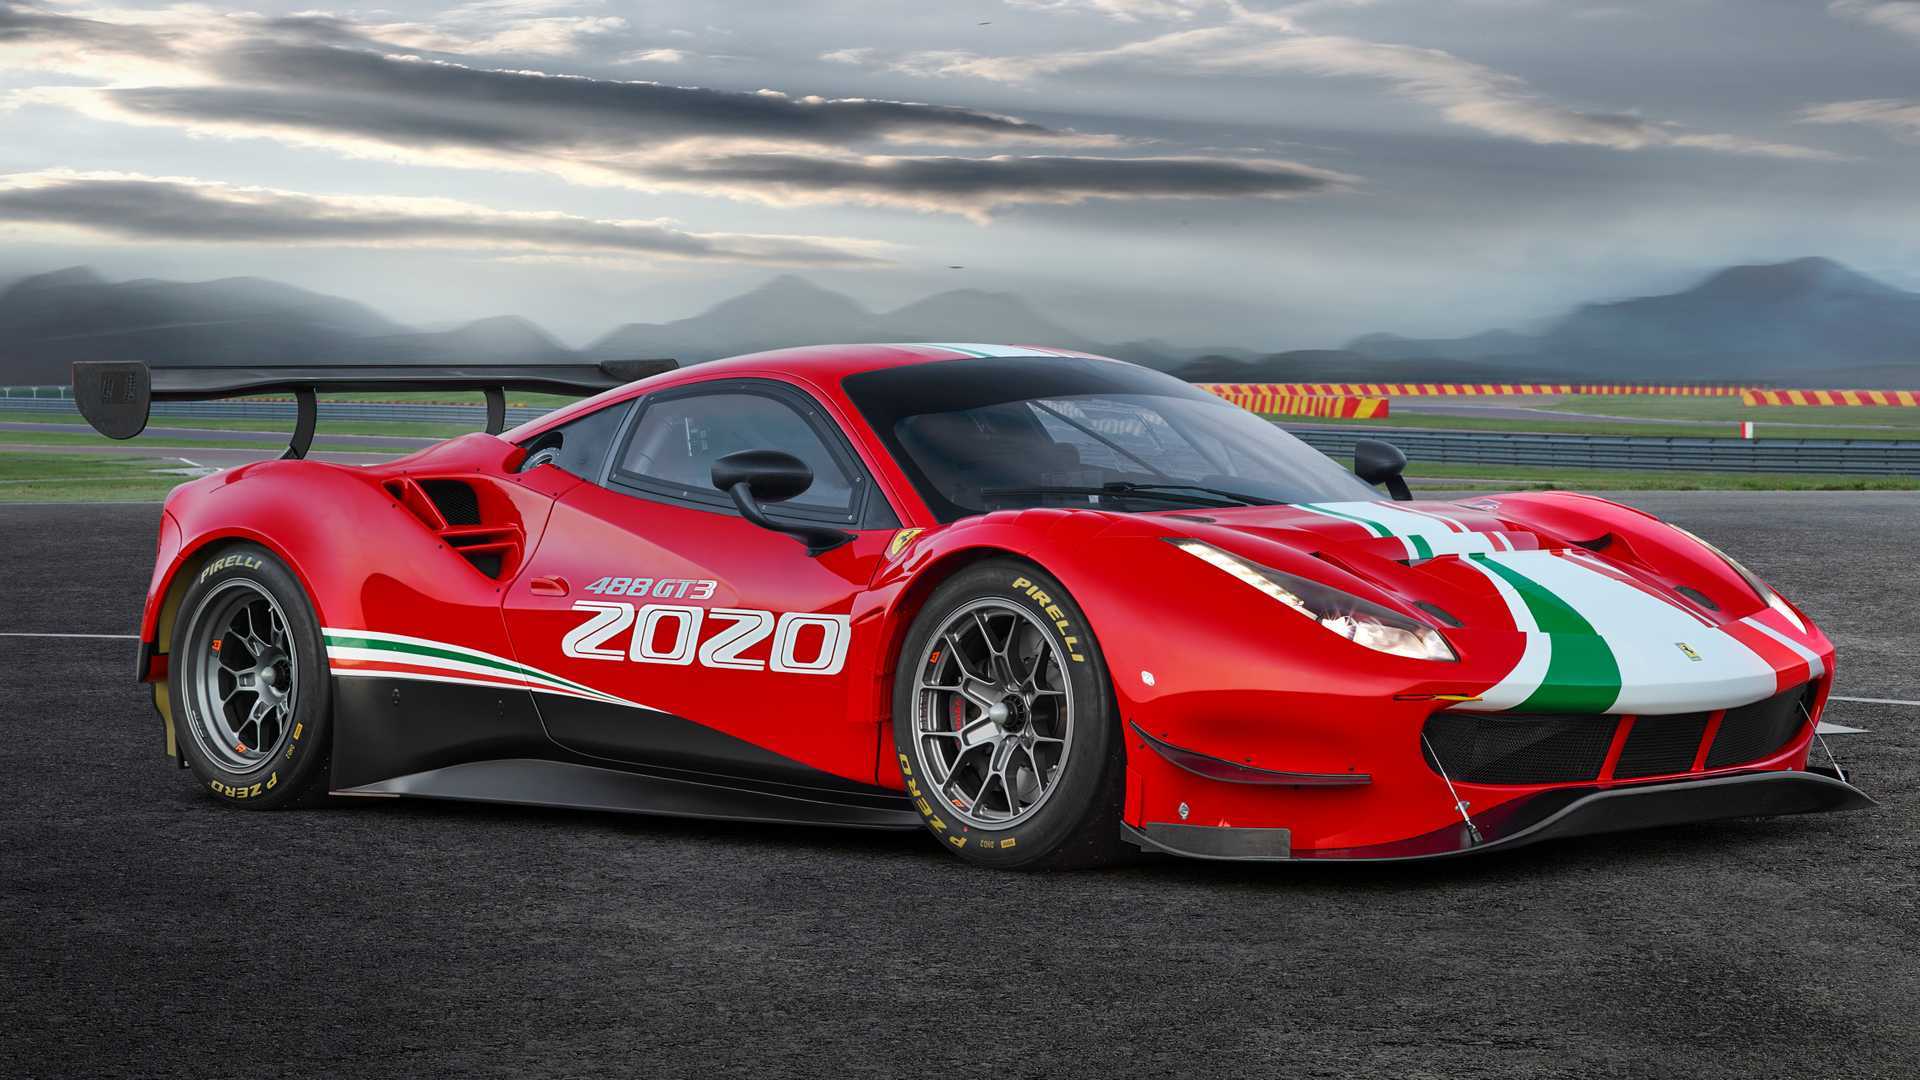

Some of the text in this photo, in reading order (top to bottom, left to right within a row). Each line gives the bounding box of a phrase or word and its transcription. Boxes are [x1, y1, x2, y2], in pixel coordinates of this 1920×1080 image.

[200, 555, 262, 584] PIRELLI
[584, 576, 717, 600] 488 GT3
[561, 600, 851, 676] 2020
[1012, 577, 1084, 662] PIRELLI
[210, 771, 278, 799] P ZERO
[899, 753, 967, 848] P ZERO
